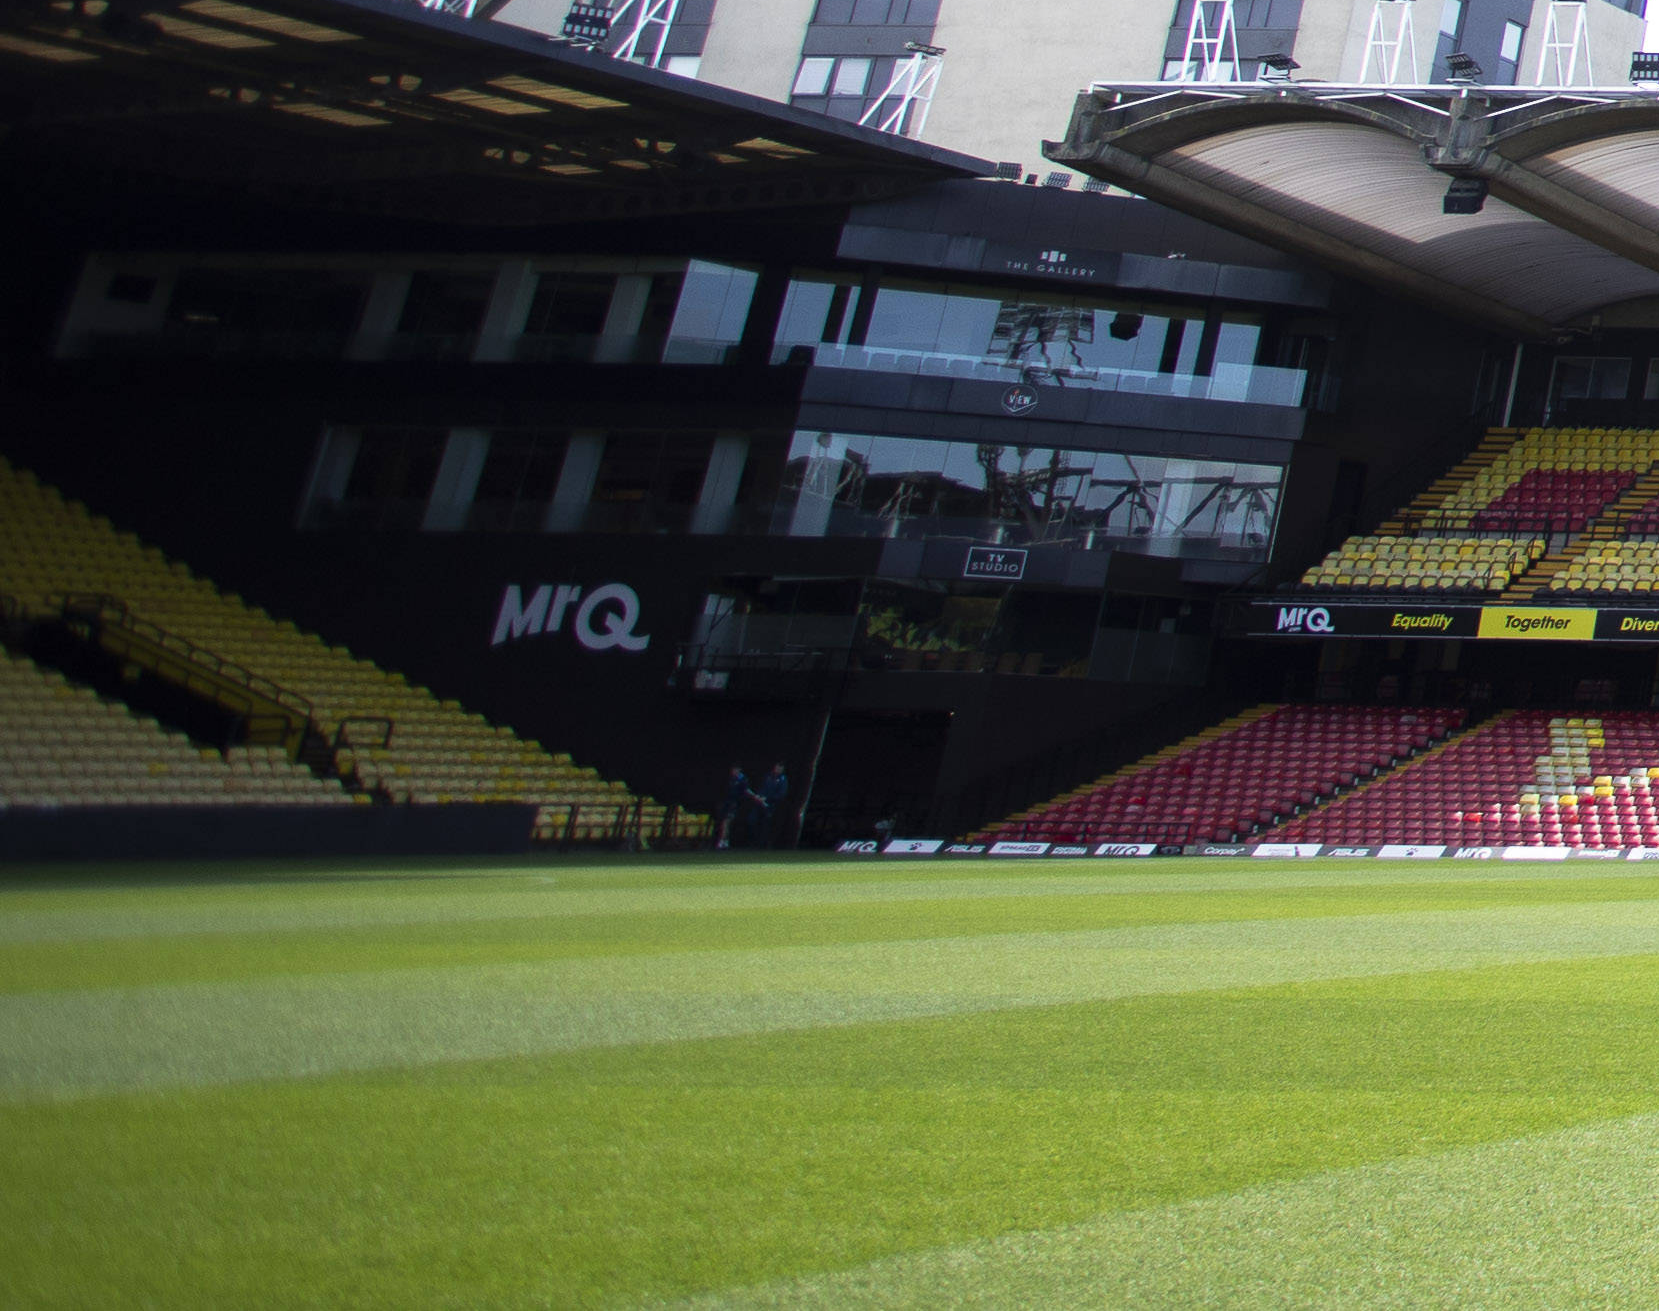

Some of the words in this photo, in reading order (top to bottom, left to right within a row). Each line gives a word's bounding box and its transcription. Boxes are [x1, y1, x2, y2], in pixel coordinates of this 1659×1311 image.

[1006, 261, 1029, 271] THE
[1036, 264, 1096, 277] GALLERY
[987, 553, 1006, 563] TV
[971, 562, 1019, 574] STUDIO
[490, 582, 652, 652] MrQ
[1276, 607, 1335, 632] MrQ
[1391, 613, 1454, 632] Equality
[1504, 614, 1571, 632] Together
[838, 840, 878, 853] MrQ
[945, 844, 986, 853] ASUS
[1328, 848, 1370, 856] ASUS
